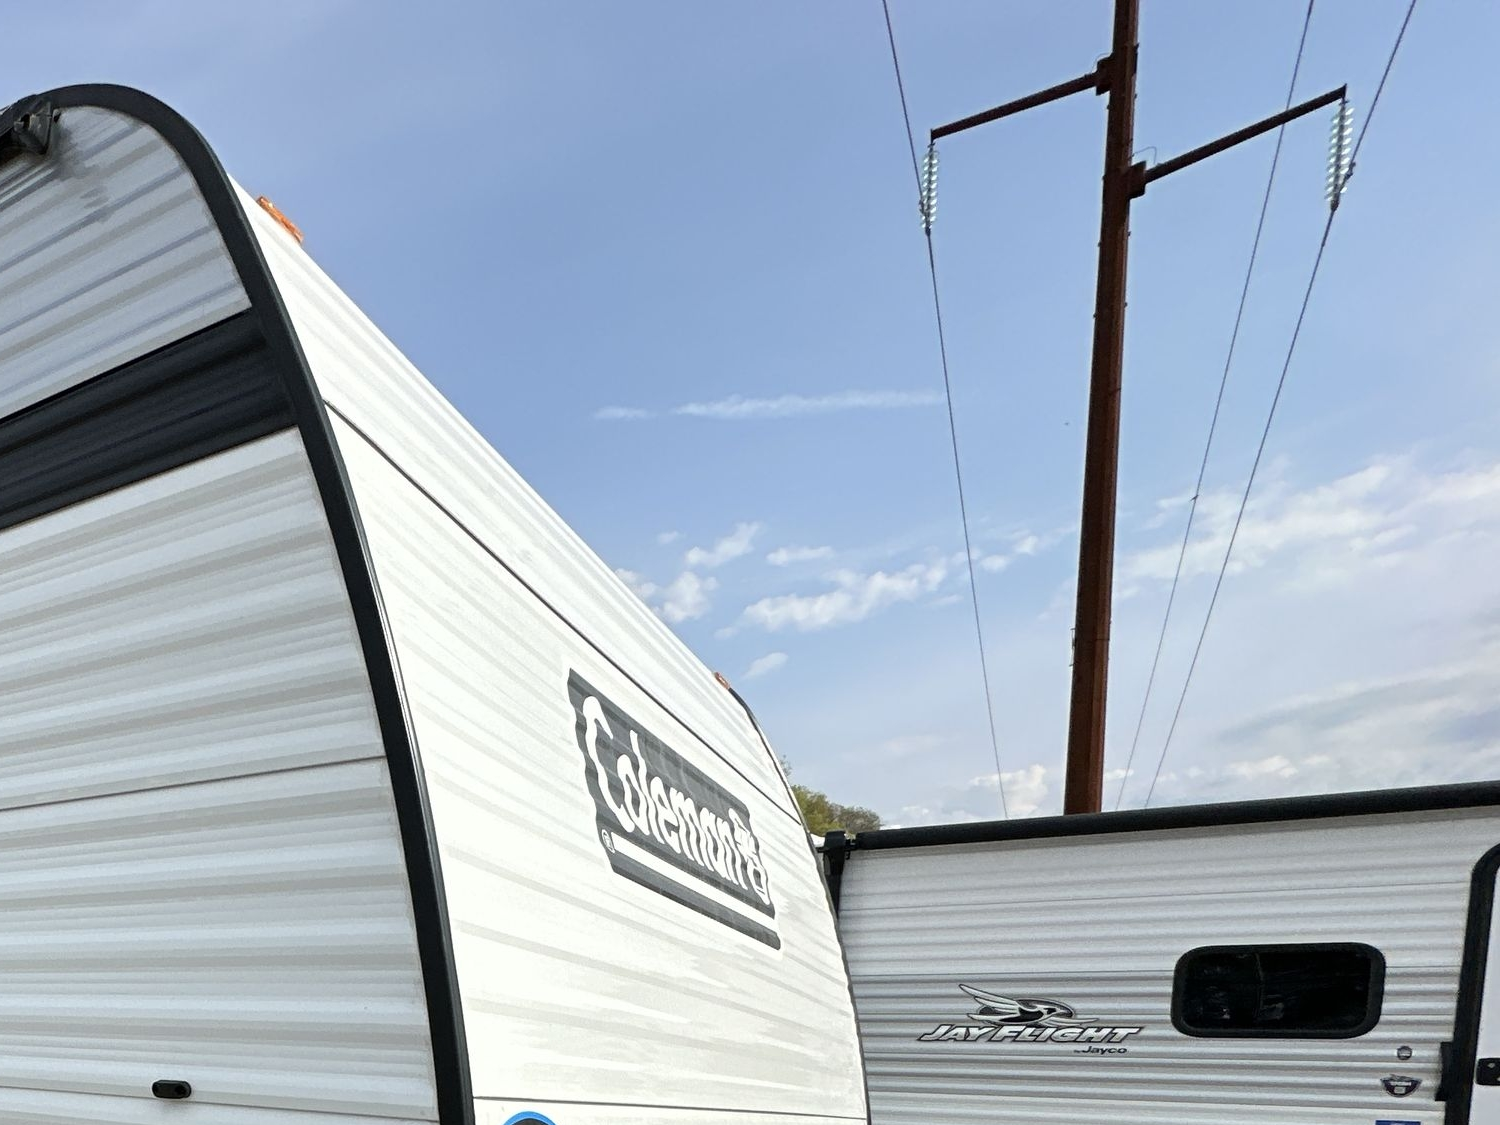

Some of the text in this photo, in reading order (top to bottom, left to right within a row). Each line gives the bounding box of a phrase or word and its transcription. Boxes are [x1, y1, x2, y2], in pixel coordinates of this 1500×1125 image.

[583, 696, 771, 905] Coleman
[918, 1024, 1145, 1043] JAY FLIGHT
[1082, 1046, 1127, 1055] Jayco
